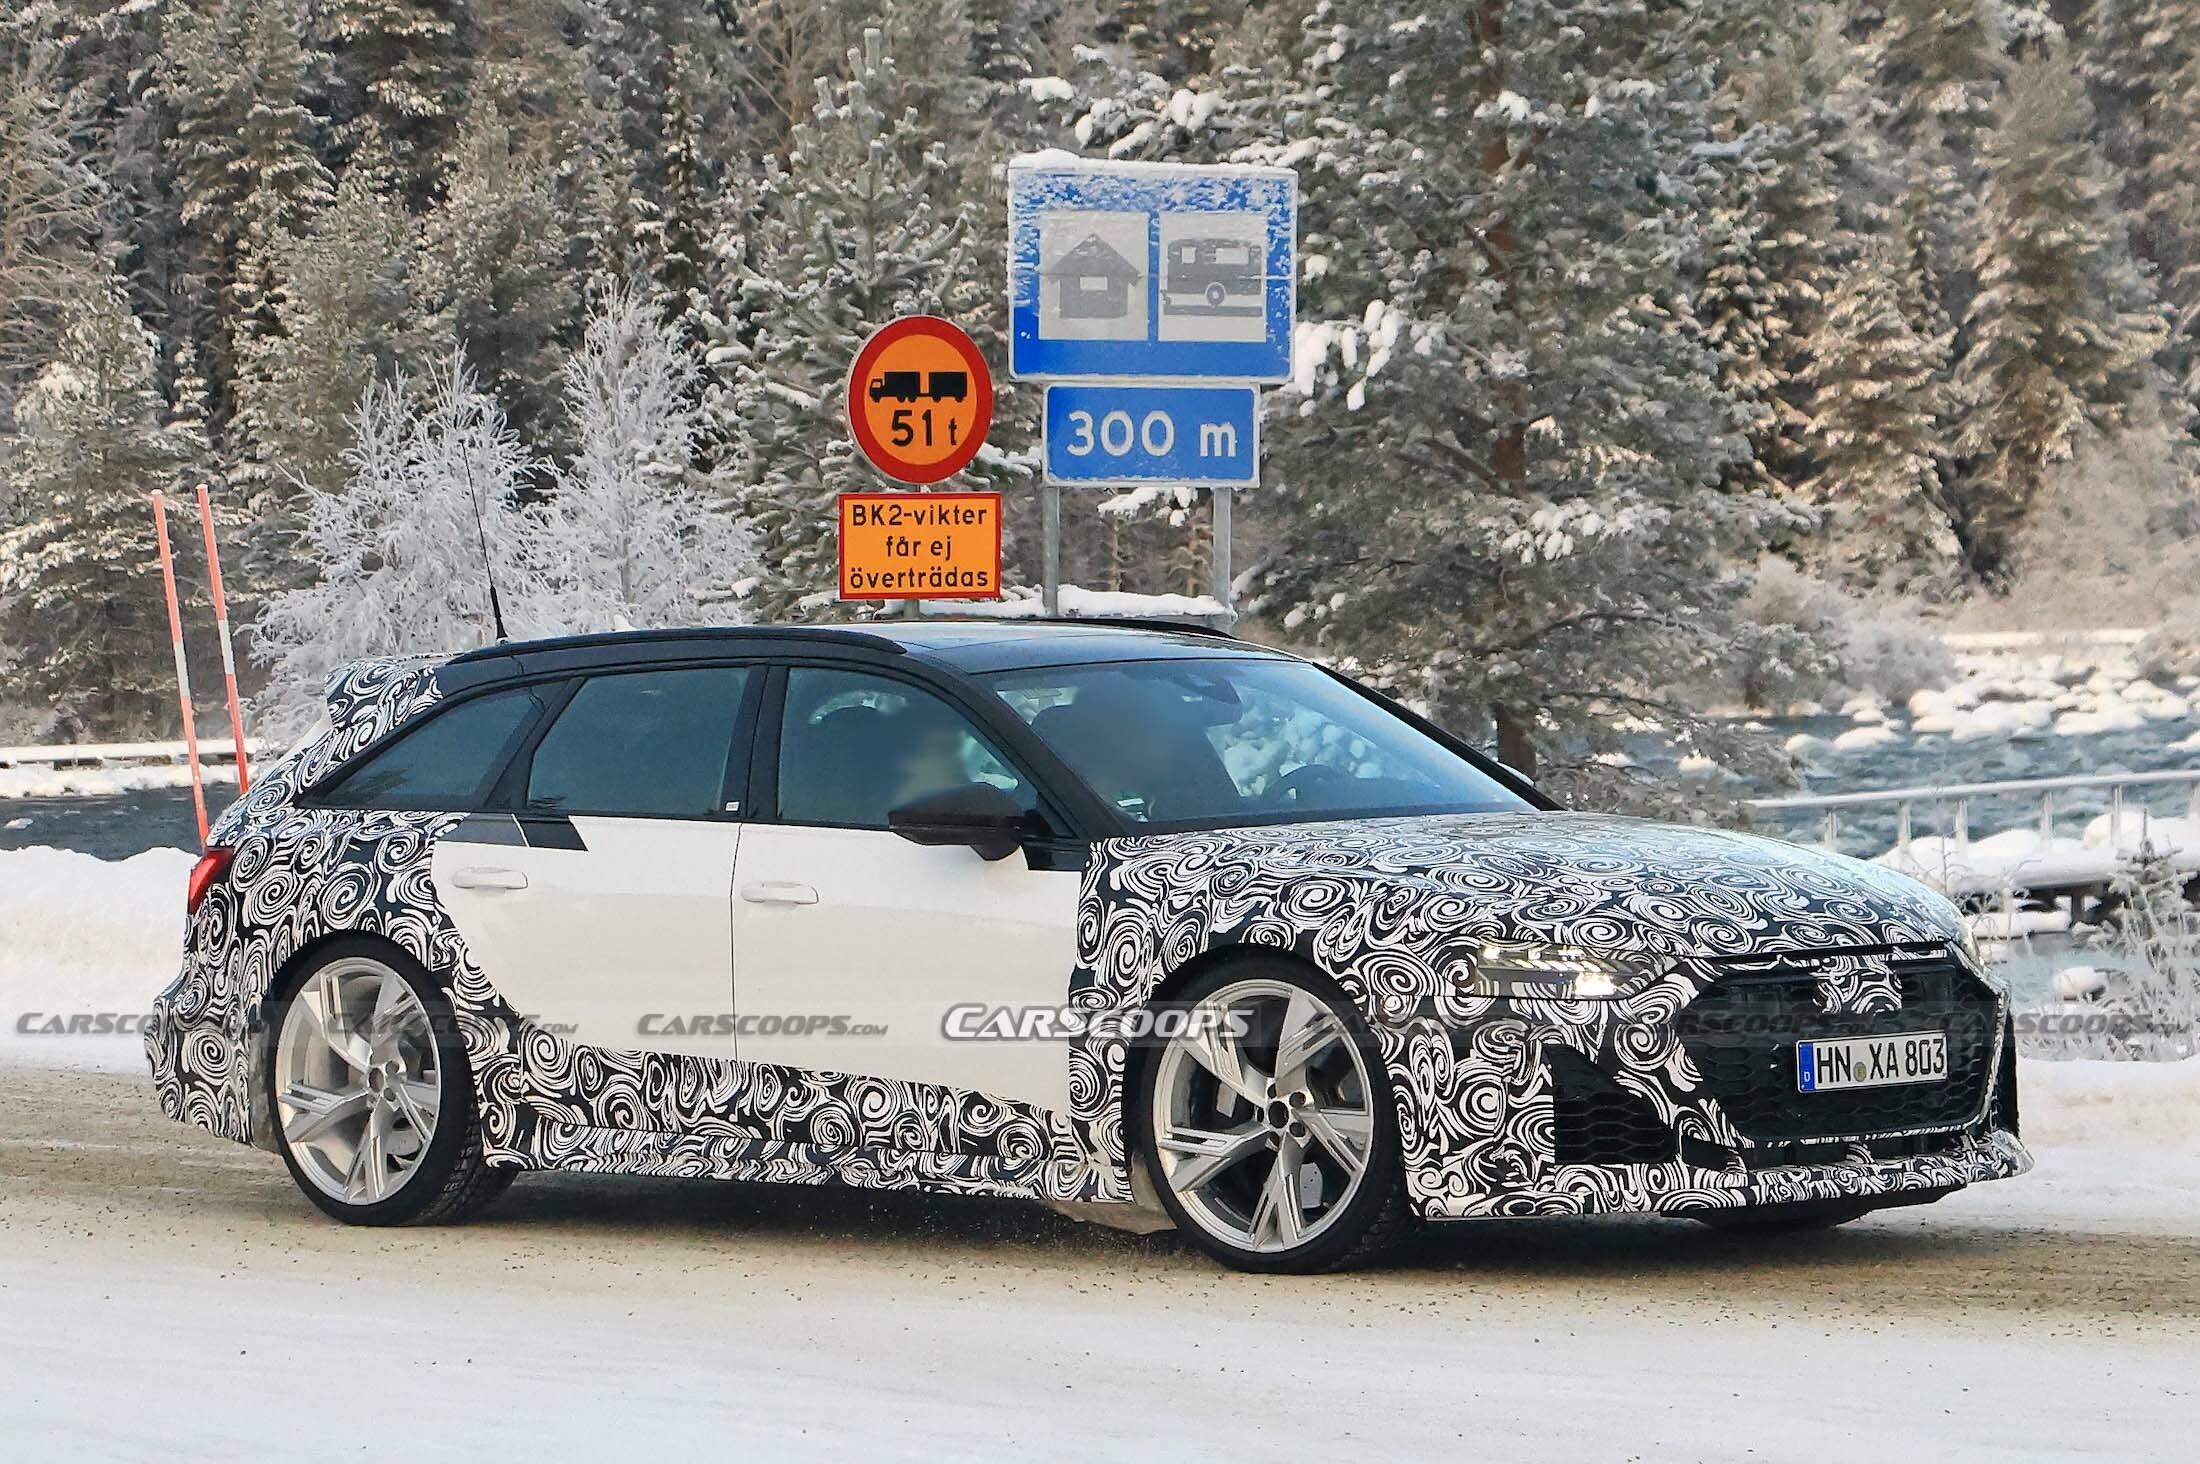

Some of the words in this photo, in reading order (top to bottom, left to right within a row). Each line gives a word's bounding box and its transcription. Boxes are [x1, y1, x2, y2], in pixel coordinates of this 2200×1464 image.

[891, 409, 933, 447] 51
[948, 418, 958, 446] t
[1067, 410, 1175, 457] 300
[1199, 421, 1238, 458] m
[852, 503, 988, 527] BK2-vikter
[886, 535, 922, 557] får
[930, 536, 953, 561] ej
[850, 565, 989, 590] överträdas
[1816, 1046, 1851, 1084] HN
[1868, 1042, 1899, 1080] XA
[1905, 1038, 1945, 1077] 803
[1804, 1071, 1811, 1082] D
